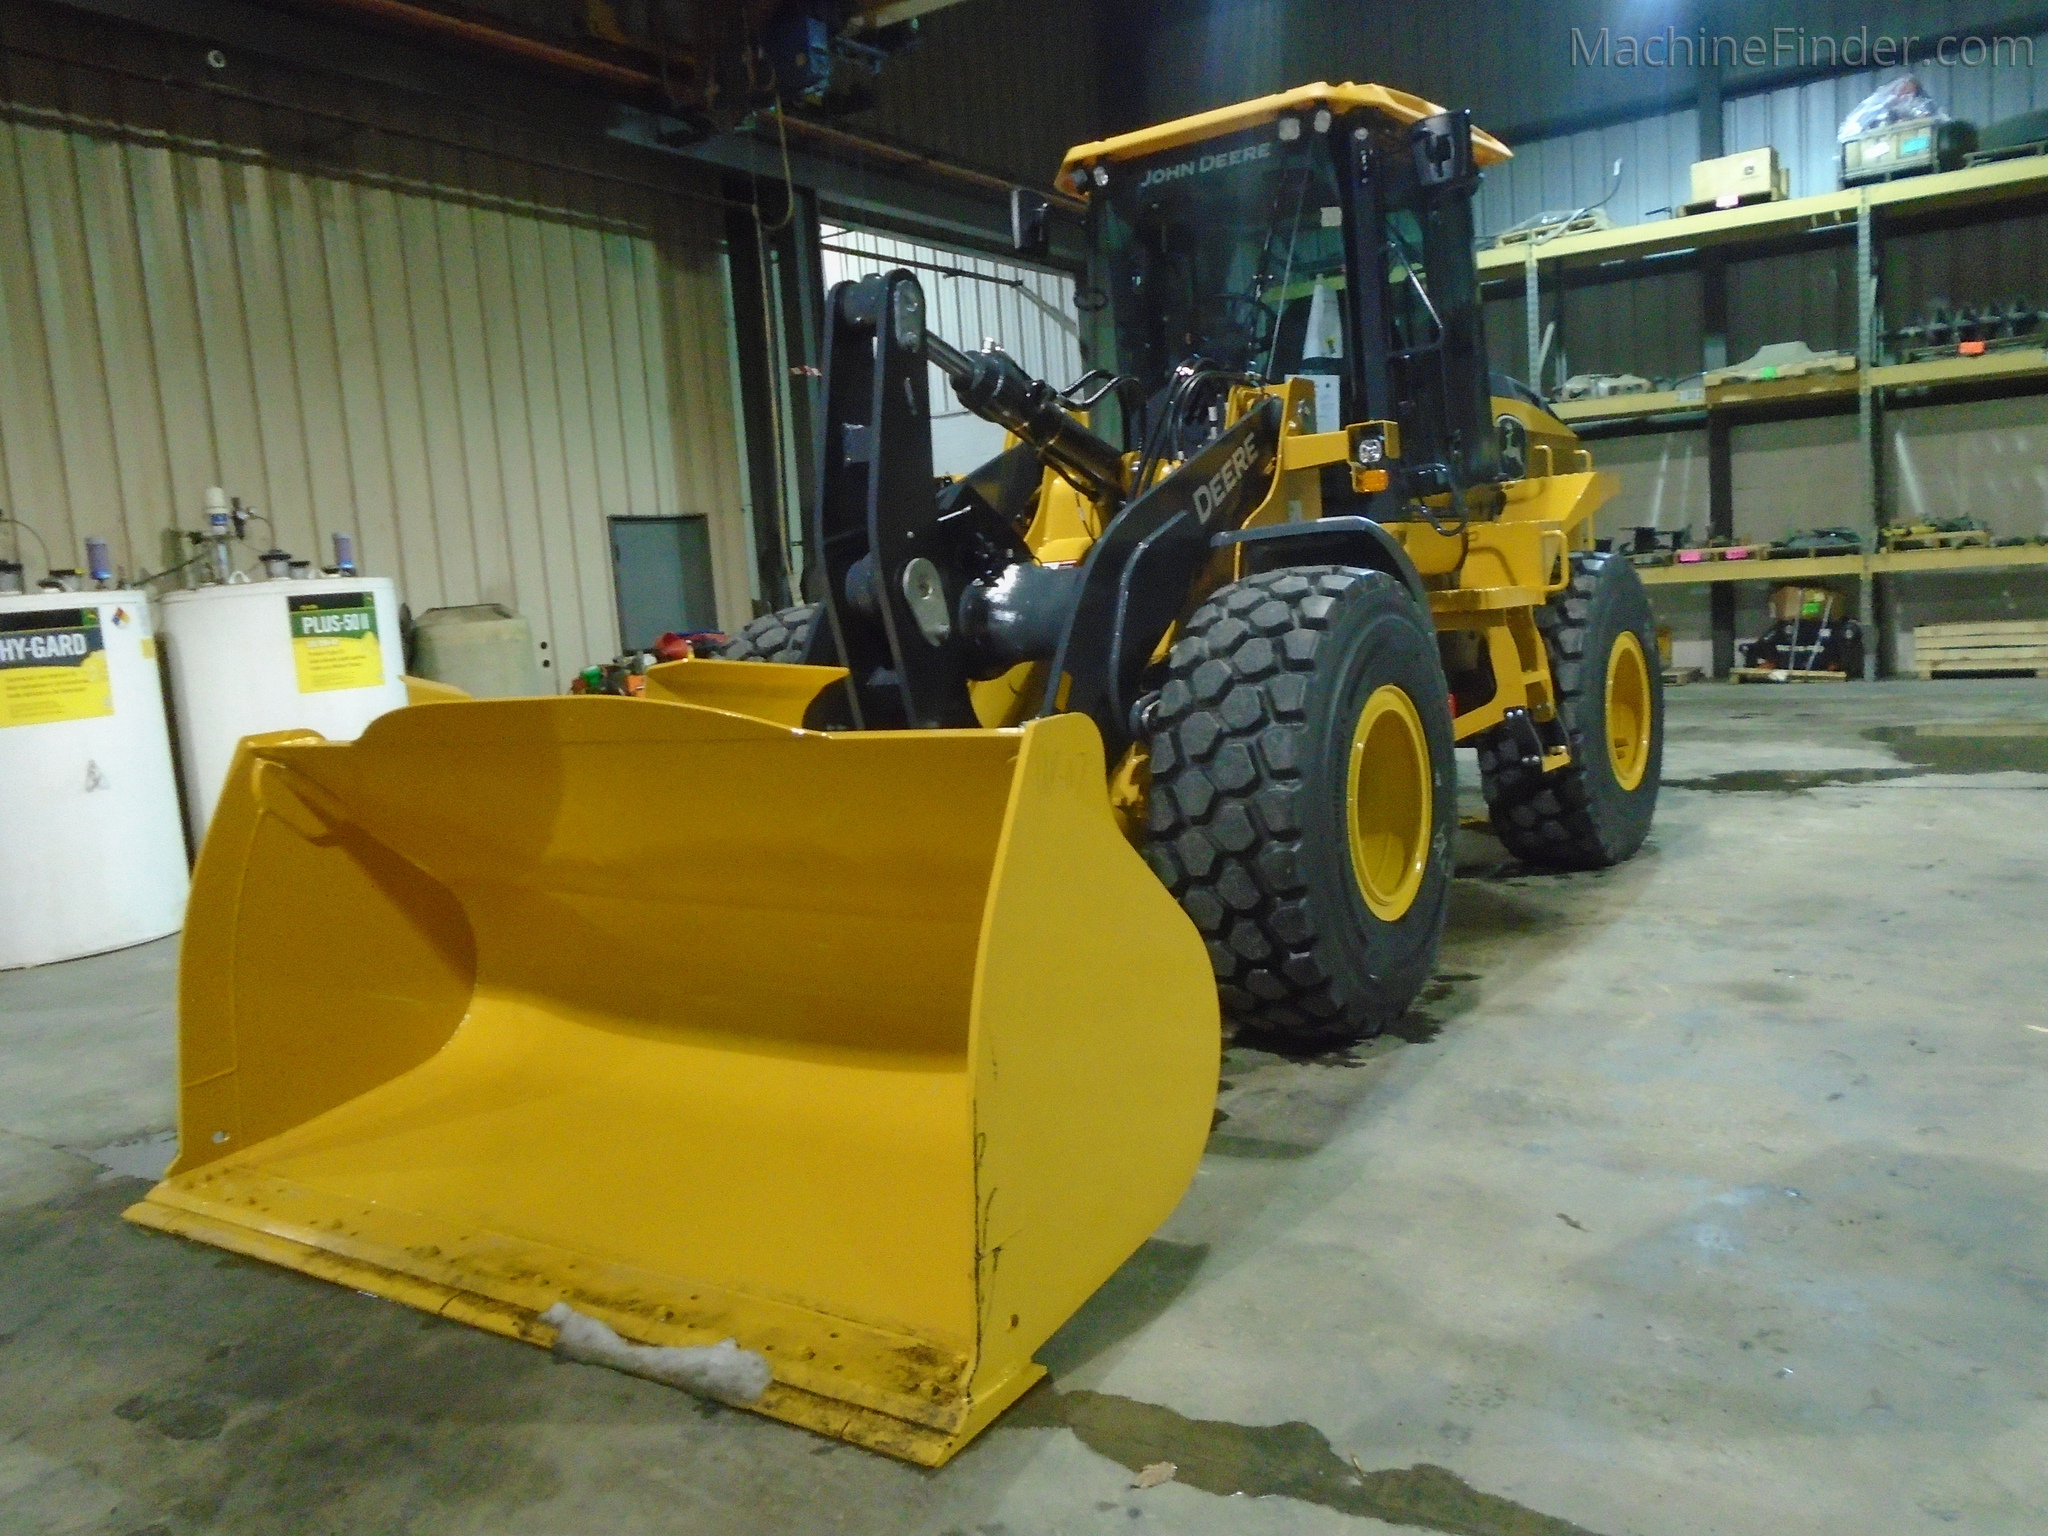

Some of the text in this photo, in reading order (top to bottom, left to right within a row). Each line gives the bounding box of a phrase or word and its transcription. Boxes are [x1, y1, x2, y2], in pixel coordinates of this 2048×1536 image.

[1140, 142, 1271, 187] JOHN DEERE
[1192, 431, 1259, 525] DEERE
[0, 632, 88, 662] HY-GARD
